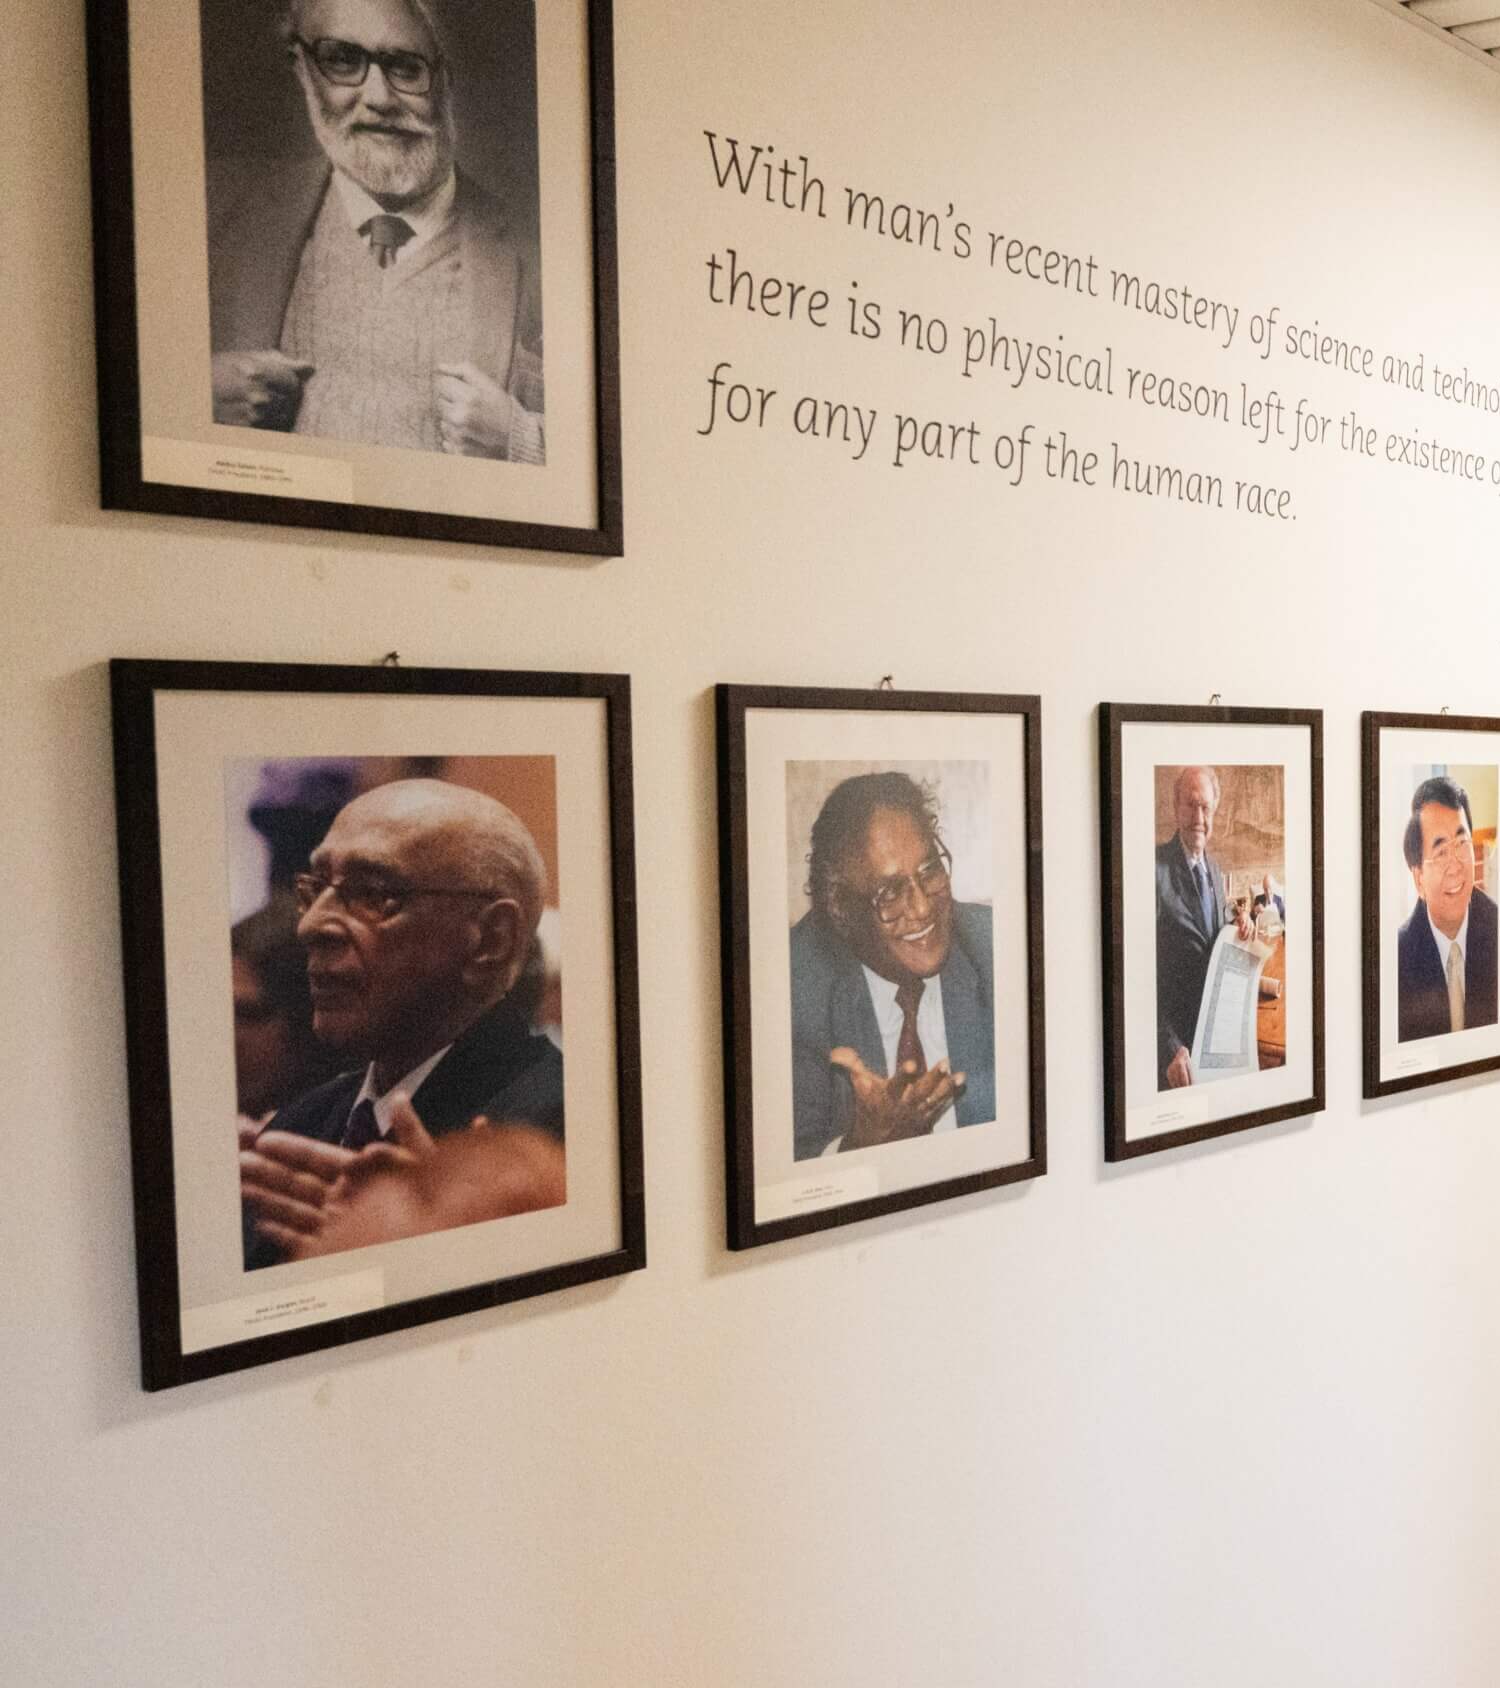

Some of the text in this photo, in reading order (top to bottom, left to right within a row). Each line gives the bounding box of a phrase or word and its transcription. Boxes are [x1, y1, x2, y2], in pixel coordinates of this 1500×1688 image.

[702, 128, 827, 220] With
[843, 186, 972, 260] man’s
[987, 231, 1100, 298] recent
[1109, 269, 1240, 350] mastery
[1249, 306, 1281, 361] of
[1284, 319, 1374, 378] science
[1381, 351, 1425, 393] and
[704, 247, 829, 329] there
[846, 279, 882, 341] is
[897, 309, 949, 355] no
[960, 317, 1115, 396] physical
[1126, 367, 1230, 423] reason
[1240, 381, 1286, 445] left
[1288, 398, 1334, 452] for
[1339, 410, 1378, 458] the
[1384, 427, 1486, 482] existence
[695, 361, 1298, 521] for any part of the human race.
